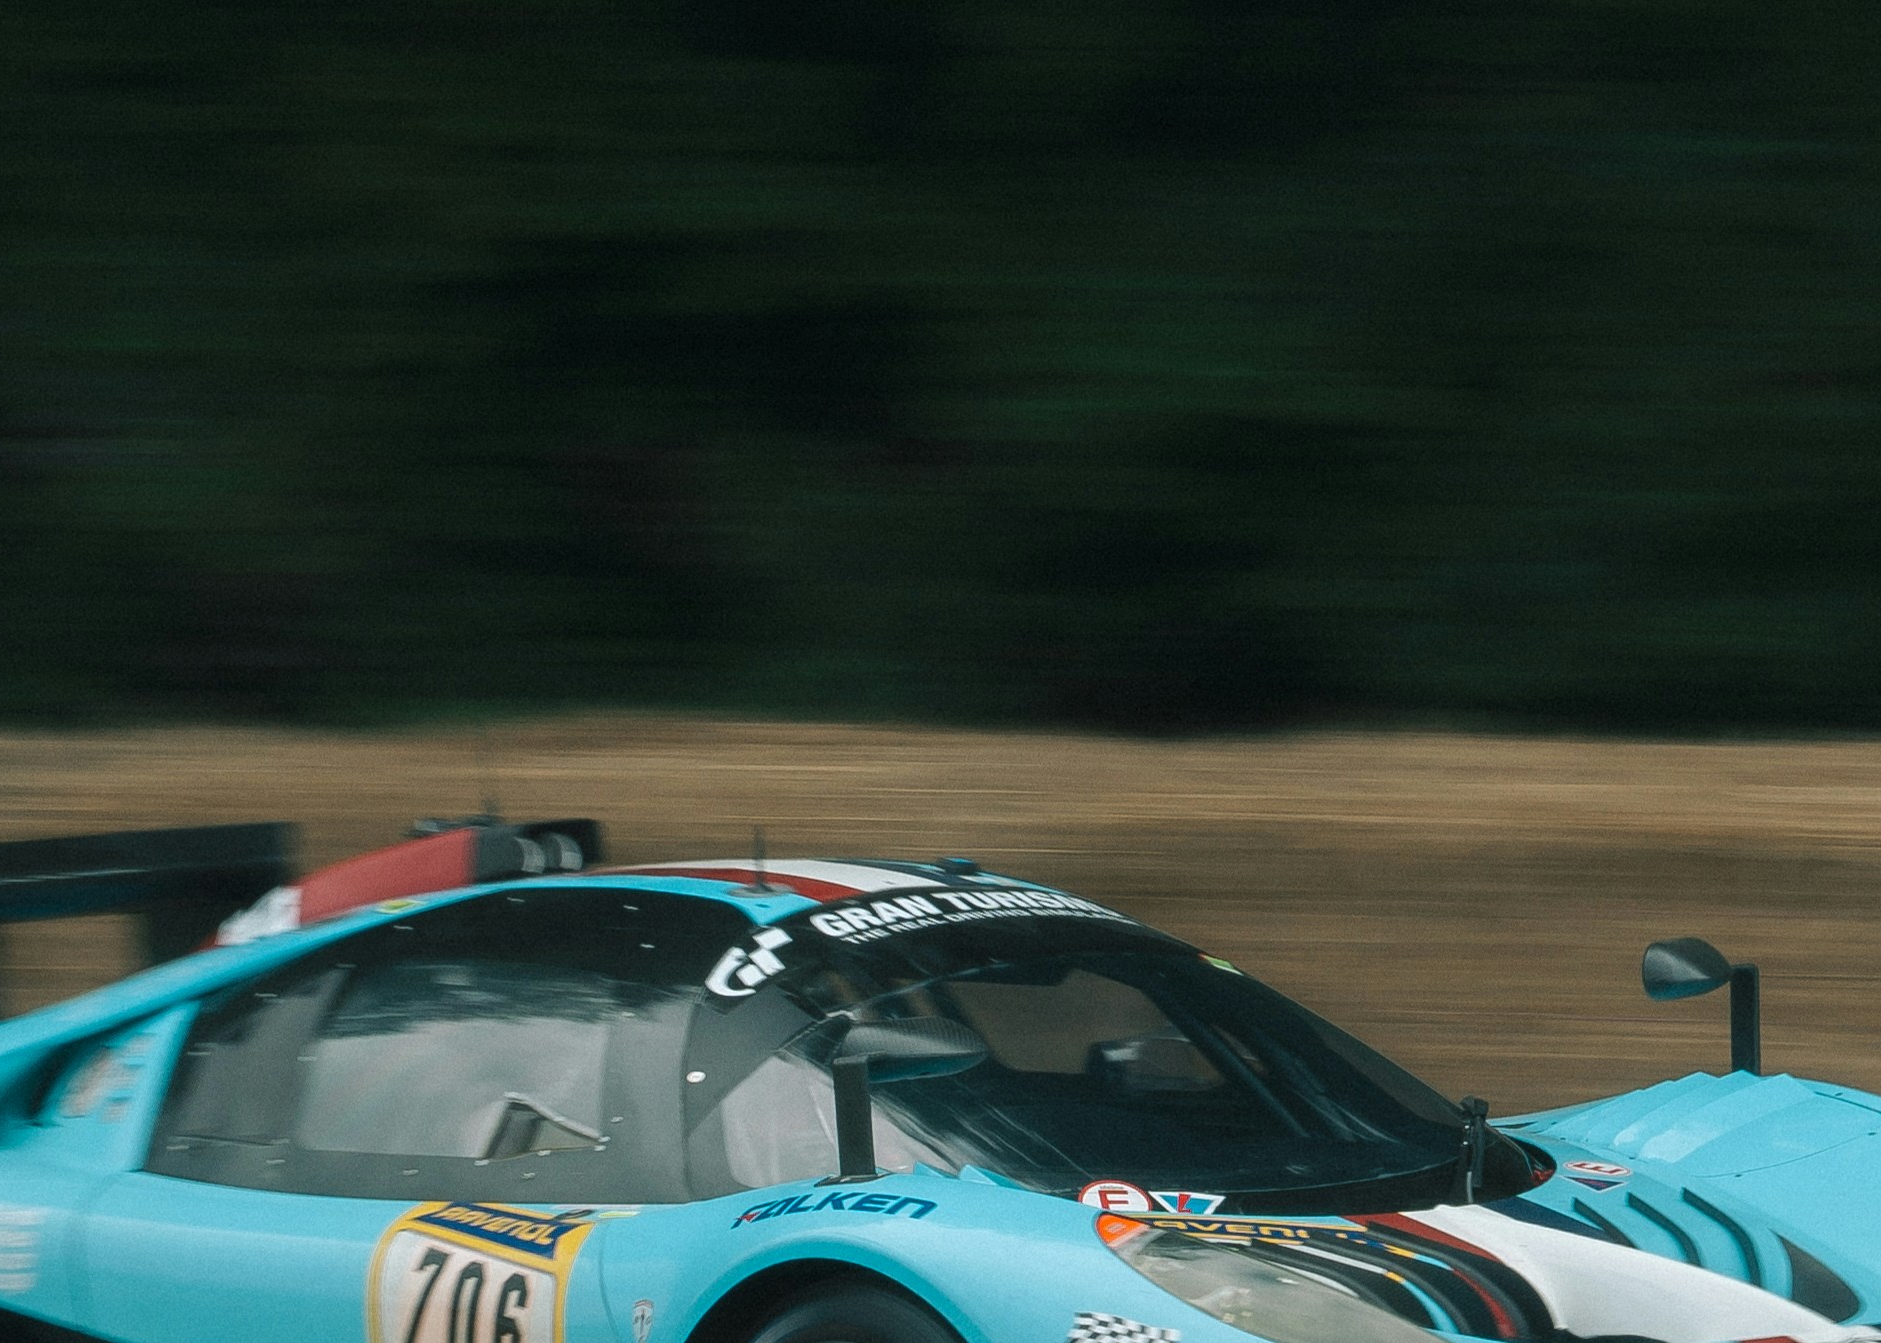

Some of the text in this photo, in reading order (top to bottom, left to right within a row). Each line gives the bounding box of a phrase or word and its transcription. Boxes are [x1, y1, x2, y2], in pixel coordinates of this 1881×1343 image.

[809, 894, 944, 938] GRAN
[839, 927, 893, 945] THE
[430, 1206, 559, 1246] RAVENOL
[730, 1191, 938, 1230] FALKEN
